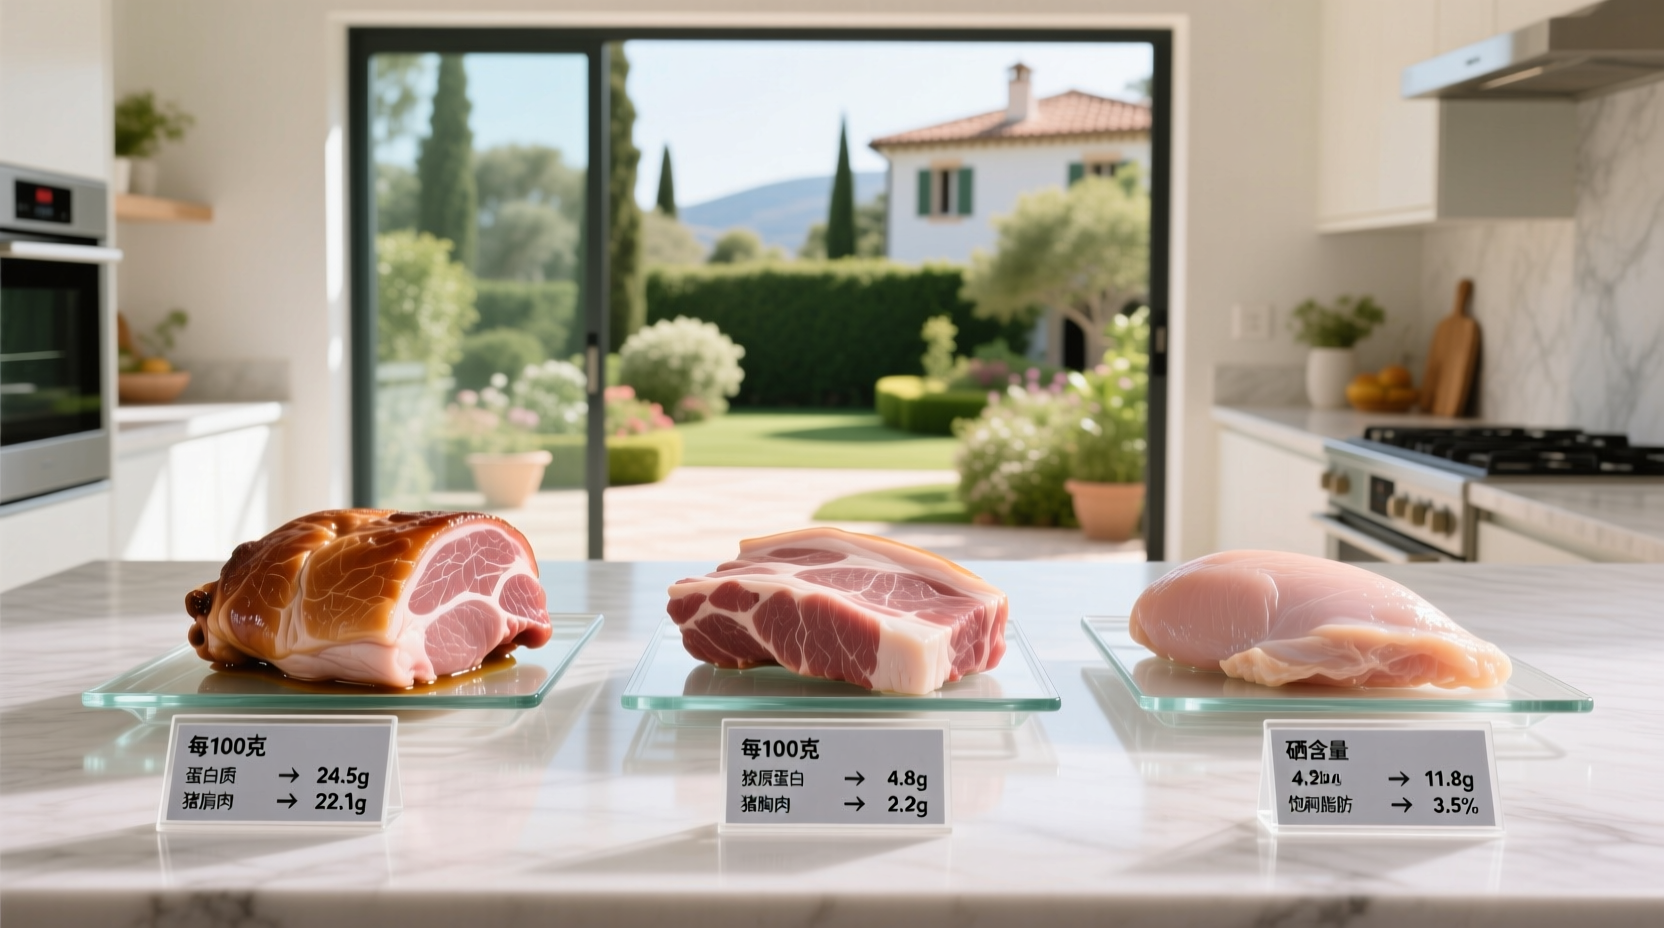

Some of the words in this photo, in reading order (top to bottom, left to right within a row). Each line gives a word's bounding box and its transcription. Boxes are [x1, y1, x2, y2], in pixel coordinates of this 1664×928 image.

[188, 734, 267, 757] 每100克
[741, 738, 820, 761] 每100克
[1285, 739, 1349, 761] 硒含量
[316, 766, 370, 789] 24.5g
[887, 769, 928, 792] 4.8g
[1425, 769, 1474, 792] 11.8g
[314, 792, 367, 815] 22.1g
[887, 795, 928, 818] 2.2g
[1433, 796, 1479, 815] 3.5%
